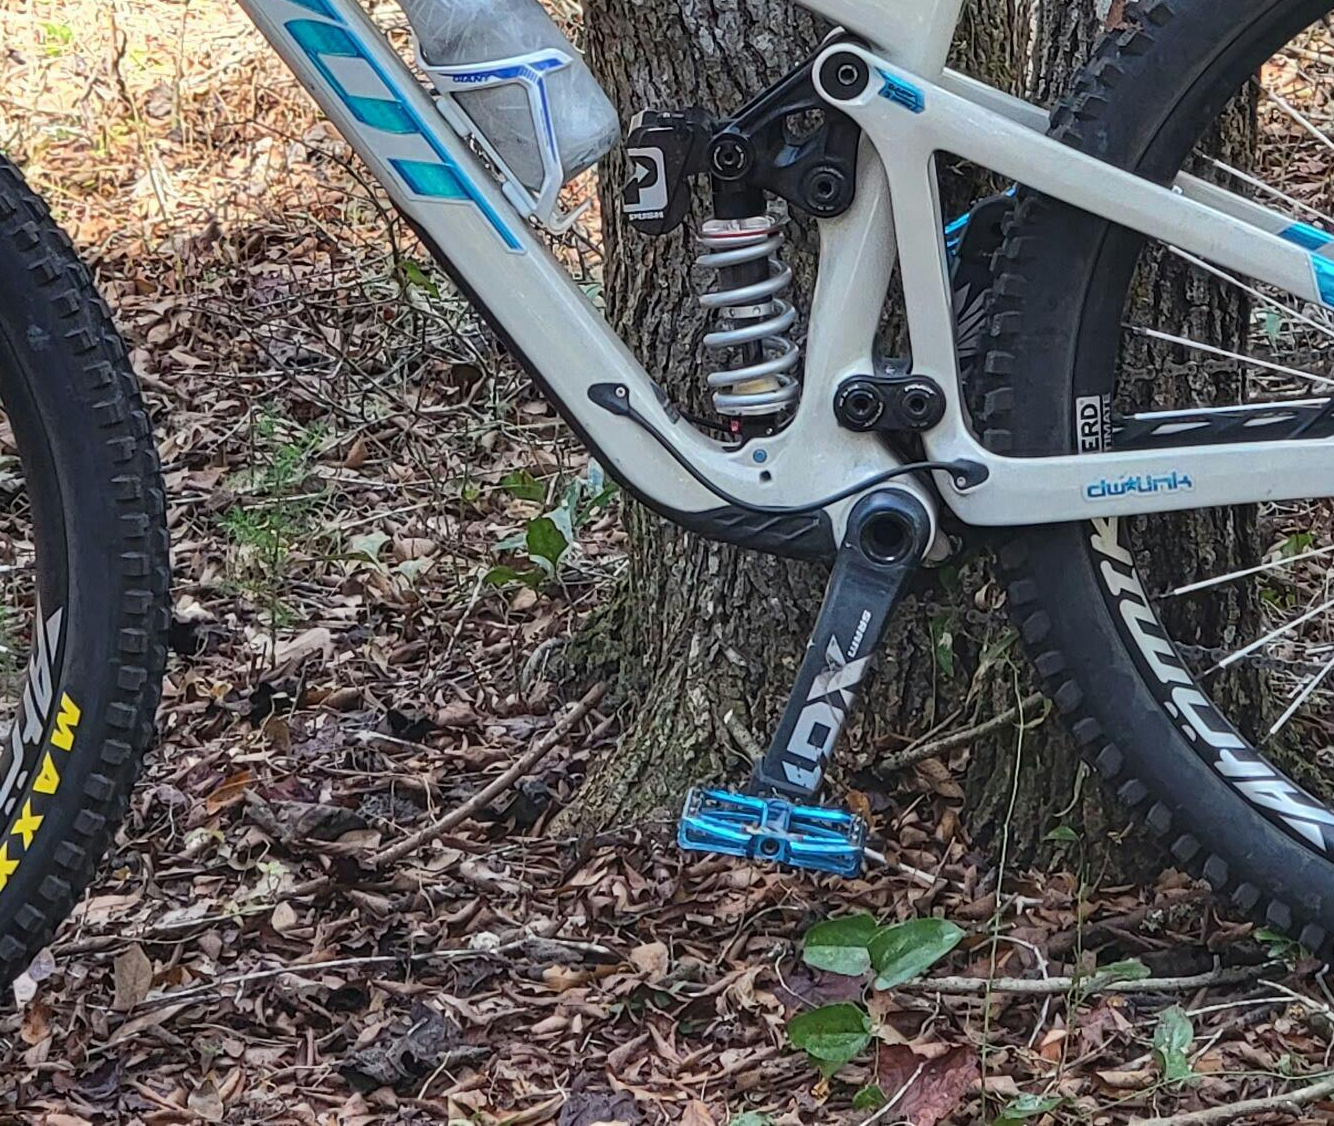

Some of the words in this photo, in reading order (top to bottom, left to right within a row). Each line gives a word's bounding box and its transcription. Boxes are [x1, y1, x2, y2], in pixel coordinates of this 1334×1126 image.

[453, 73, 488, 83] GIANT
[628, 211, 664, 221] PUSH
[1080, 403, 1100, 452] ERD
[1102, 393, 1114, 452] TIMATE
[847, 609, 872, 659] SRAM
